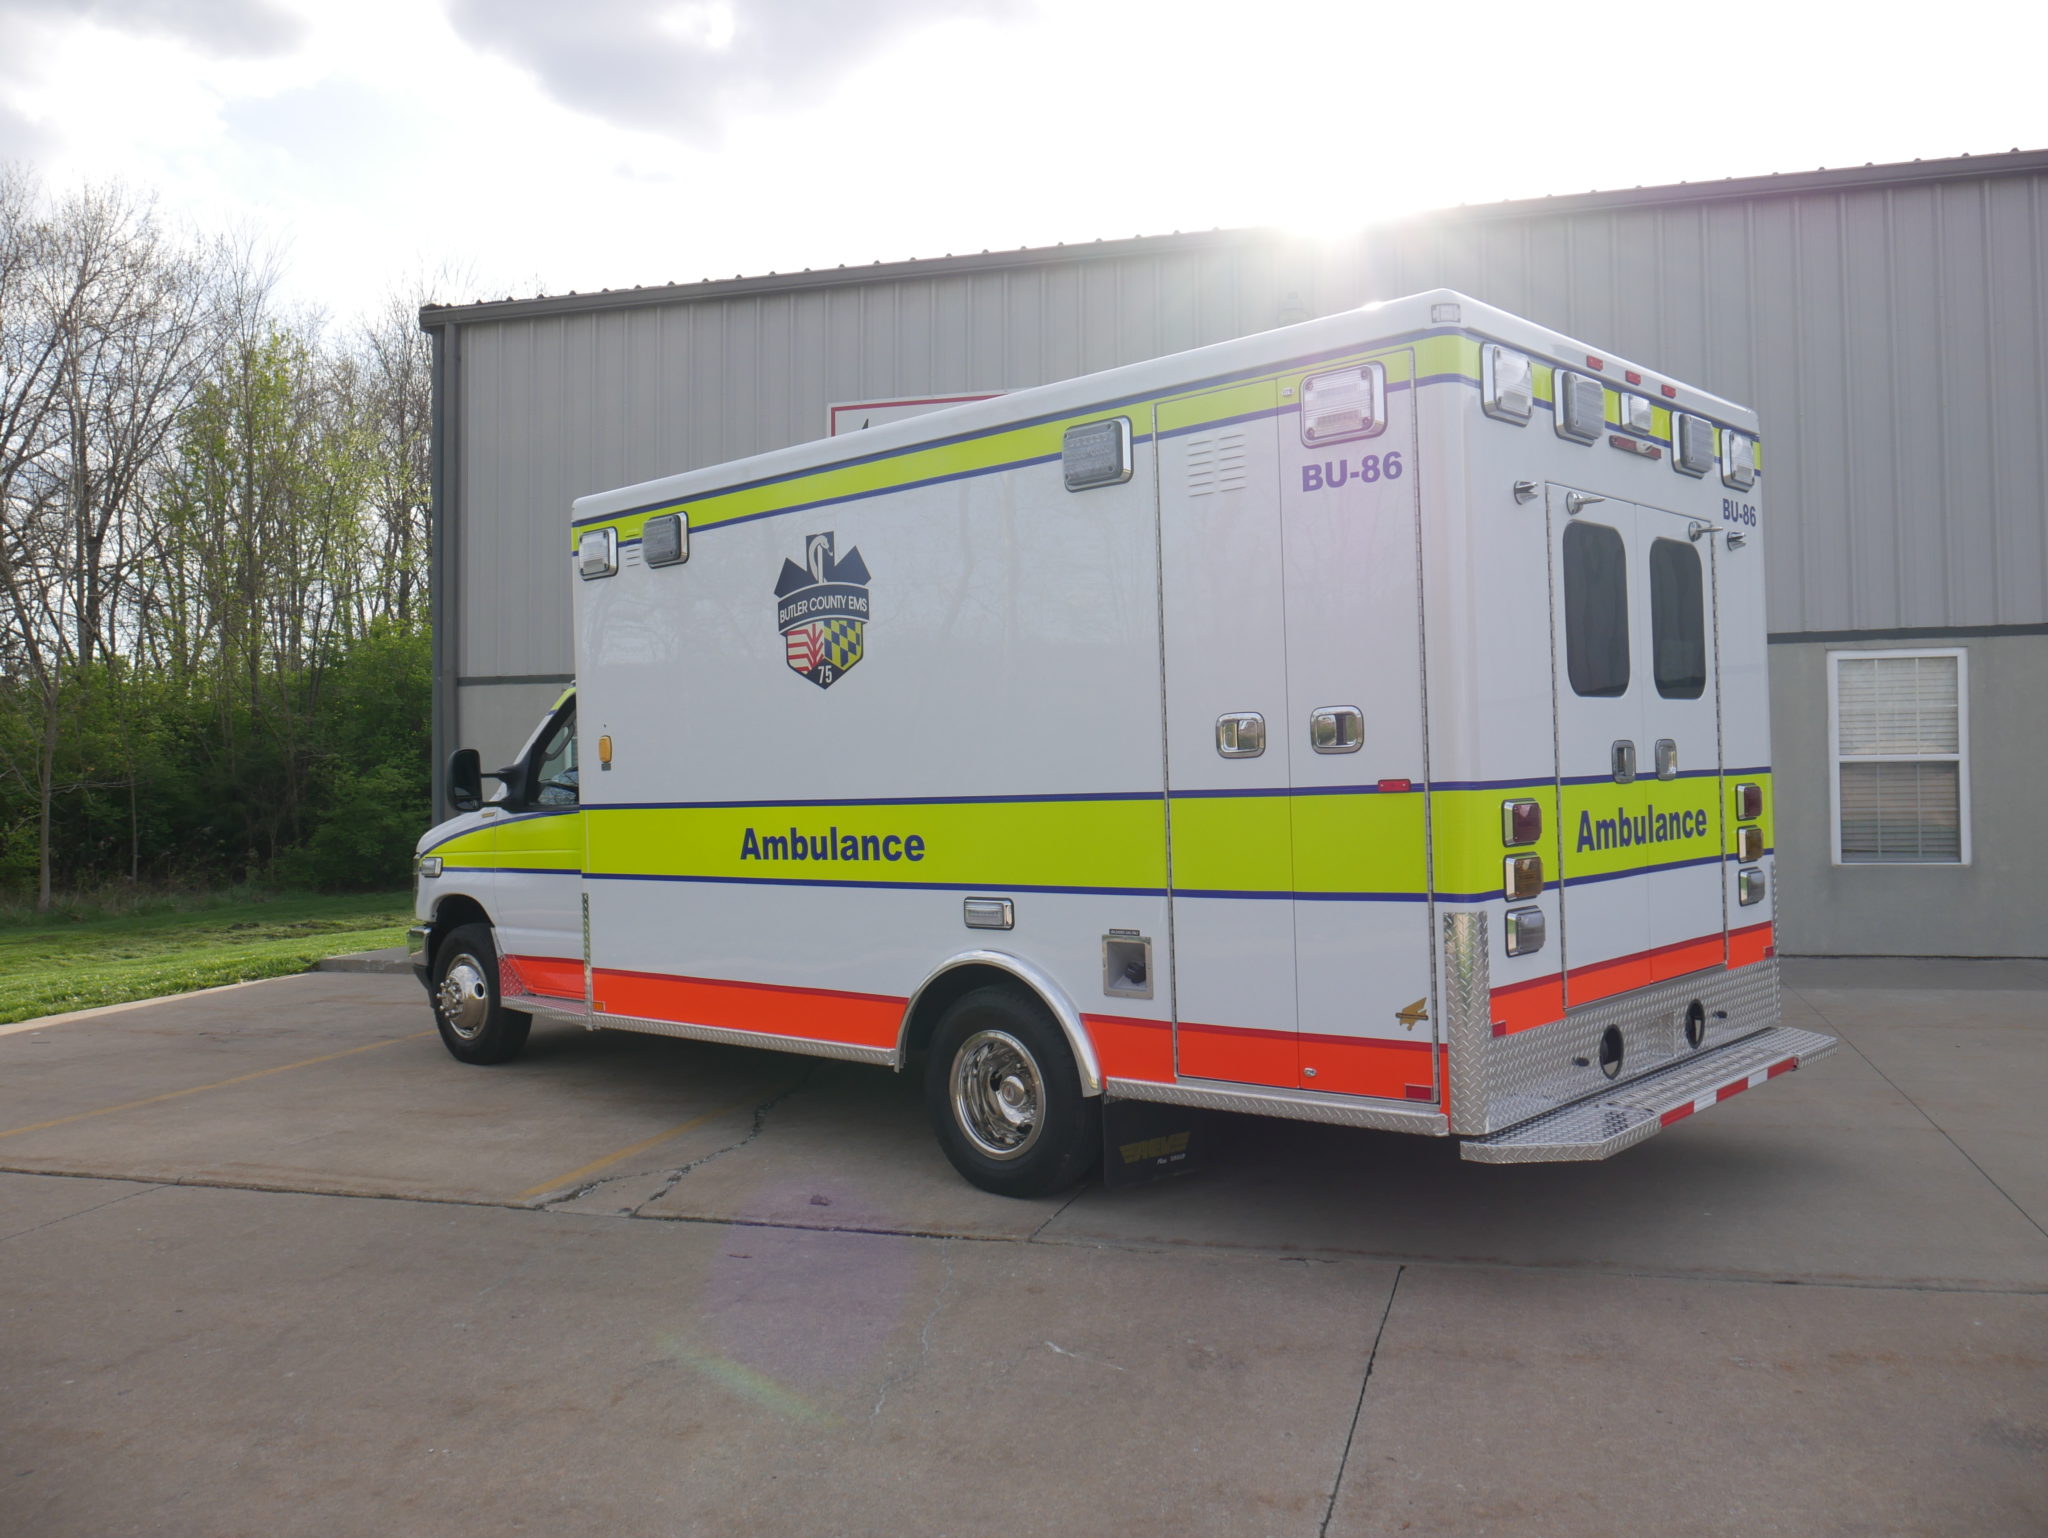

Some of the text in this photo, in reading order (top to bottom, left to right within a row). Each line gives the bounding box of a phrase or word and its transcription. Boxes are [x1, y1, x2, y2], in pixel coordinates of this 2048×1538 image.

[1301, 450, 1403, 492] BU-86
[1722, 498, 1756, 527] BU-86
[779, 595, 867, 623] BUTLER COUNTY EMS
[817, 665, 833, 684] 75
[739, 826, 926, 862] Ambulance
[1576, 804, 1708, 853] Ambulance
